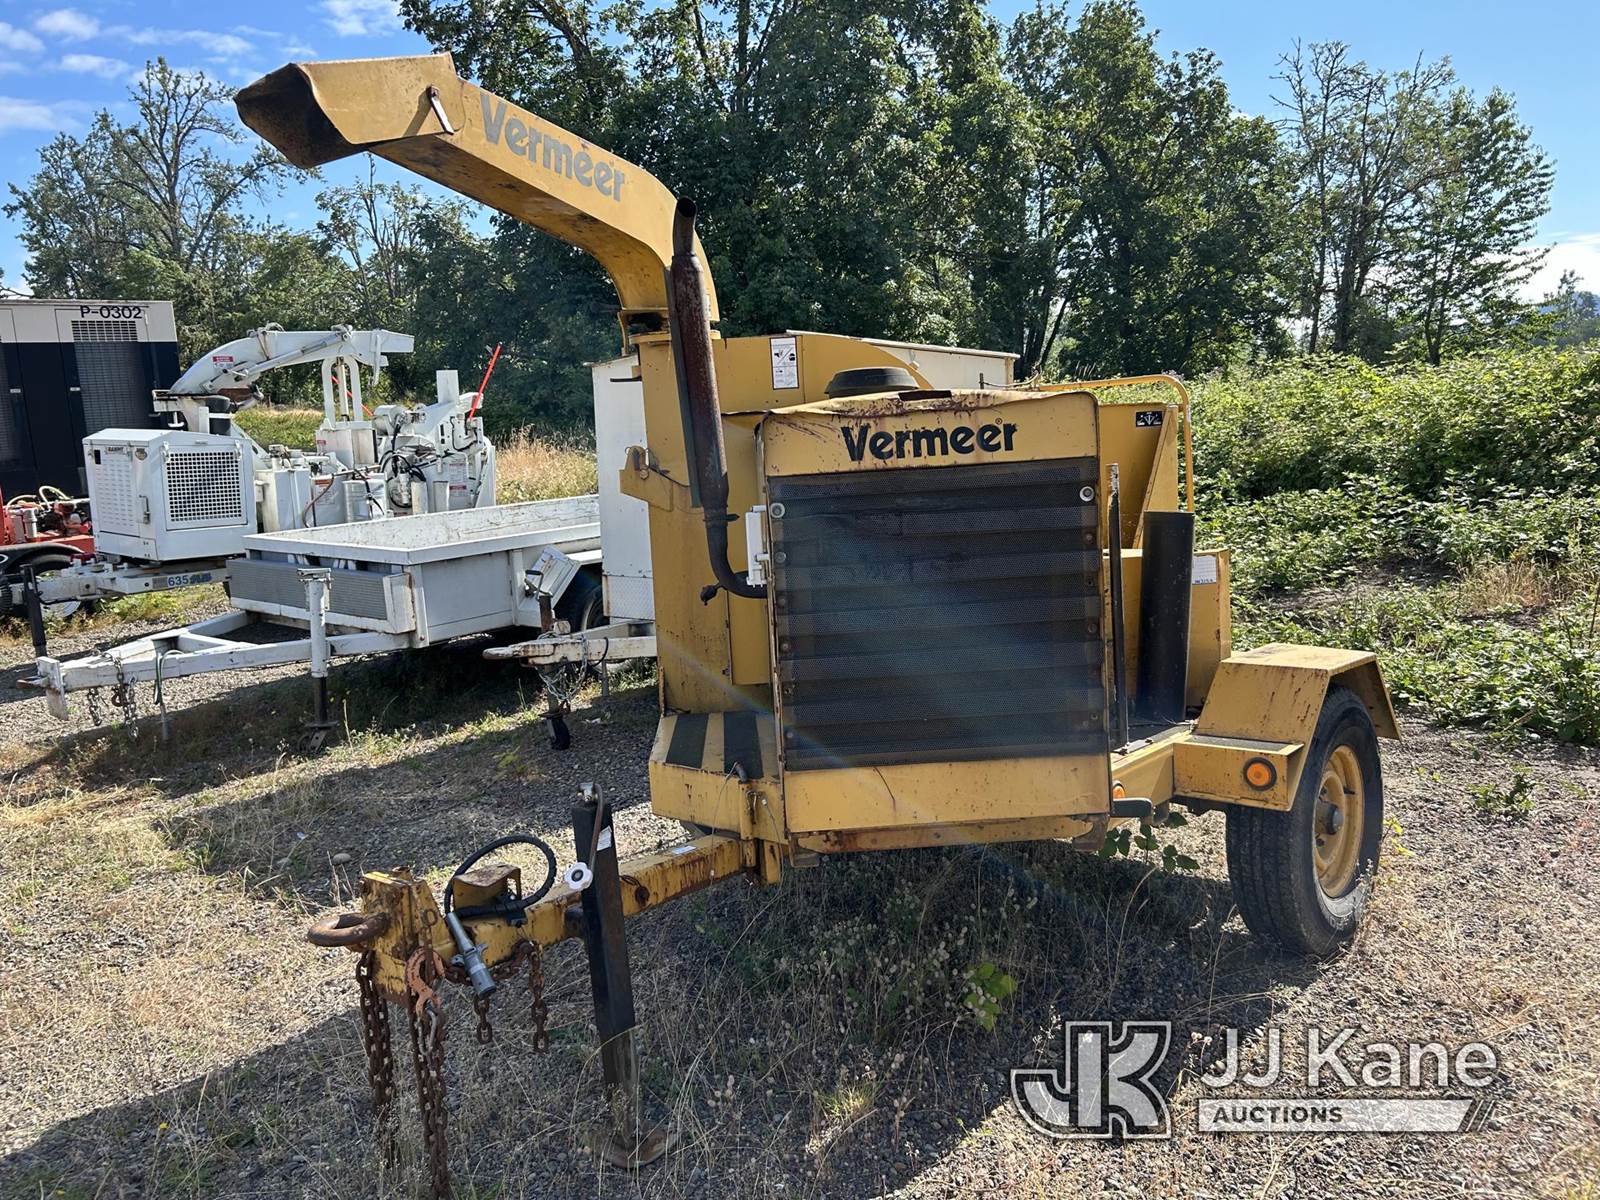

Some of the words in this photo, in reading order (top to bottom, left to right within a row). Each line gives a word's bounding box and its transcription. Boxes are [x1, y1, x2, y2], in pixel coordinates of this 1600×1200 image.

[479, 92, 625, 202] Vermeer
[80, 305, 142, 319] P-0302
[841, 422, 1018, 462] Vermeer
[168, 575, 189, 587] 635
